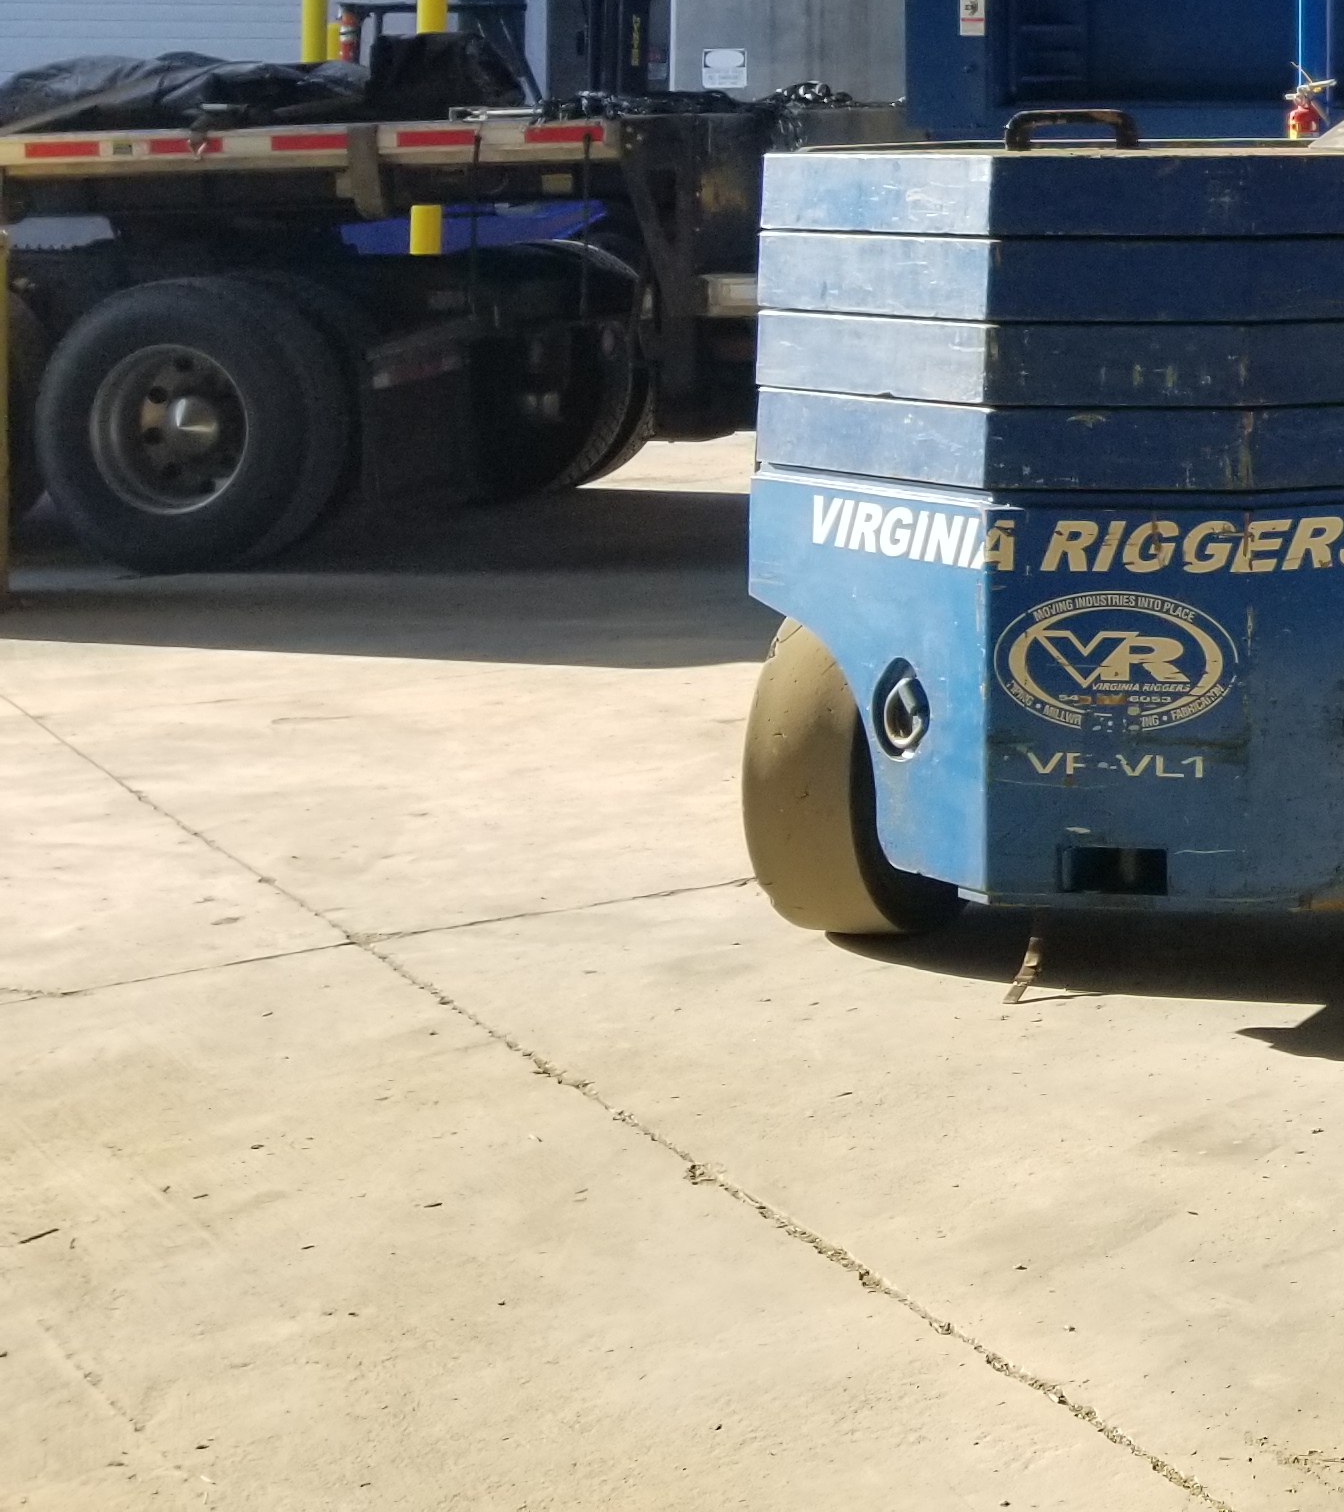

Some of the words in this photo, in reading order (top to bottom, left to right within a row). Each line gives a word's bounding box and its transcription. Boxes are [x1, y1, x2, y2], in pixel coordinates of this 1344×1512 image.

[812, 494, 1016, 570] VIRGINIA
[1033, 599, 1074, 622] MOVING
[1075, 594, 1136, 609] INDUSTRIES
[1137, 596, 1161, 611] INTO
[1163, 601, 1196, 623] PLACE
[1035, 630, 1191, 688] VR
[1092, 683, 1140, 692] VIRGINIA
[1142, 683, 1191, 693] RIGGERS
